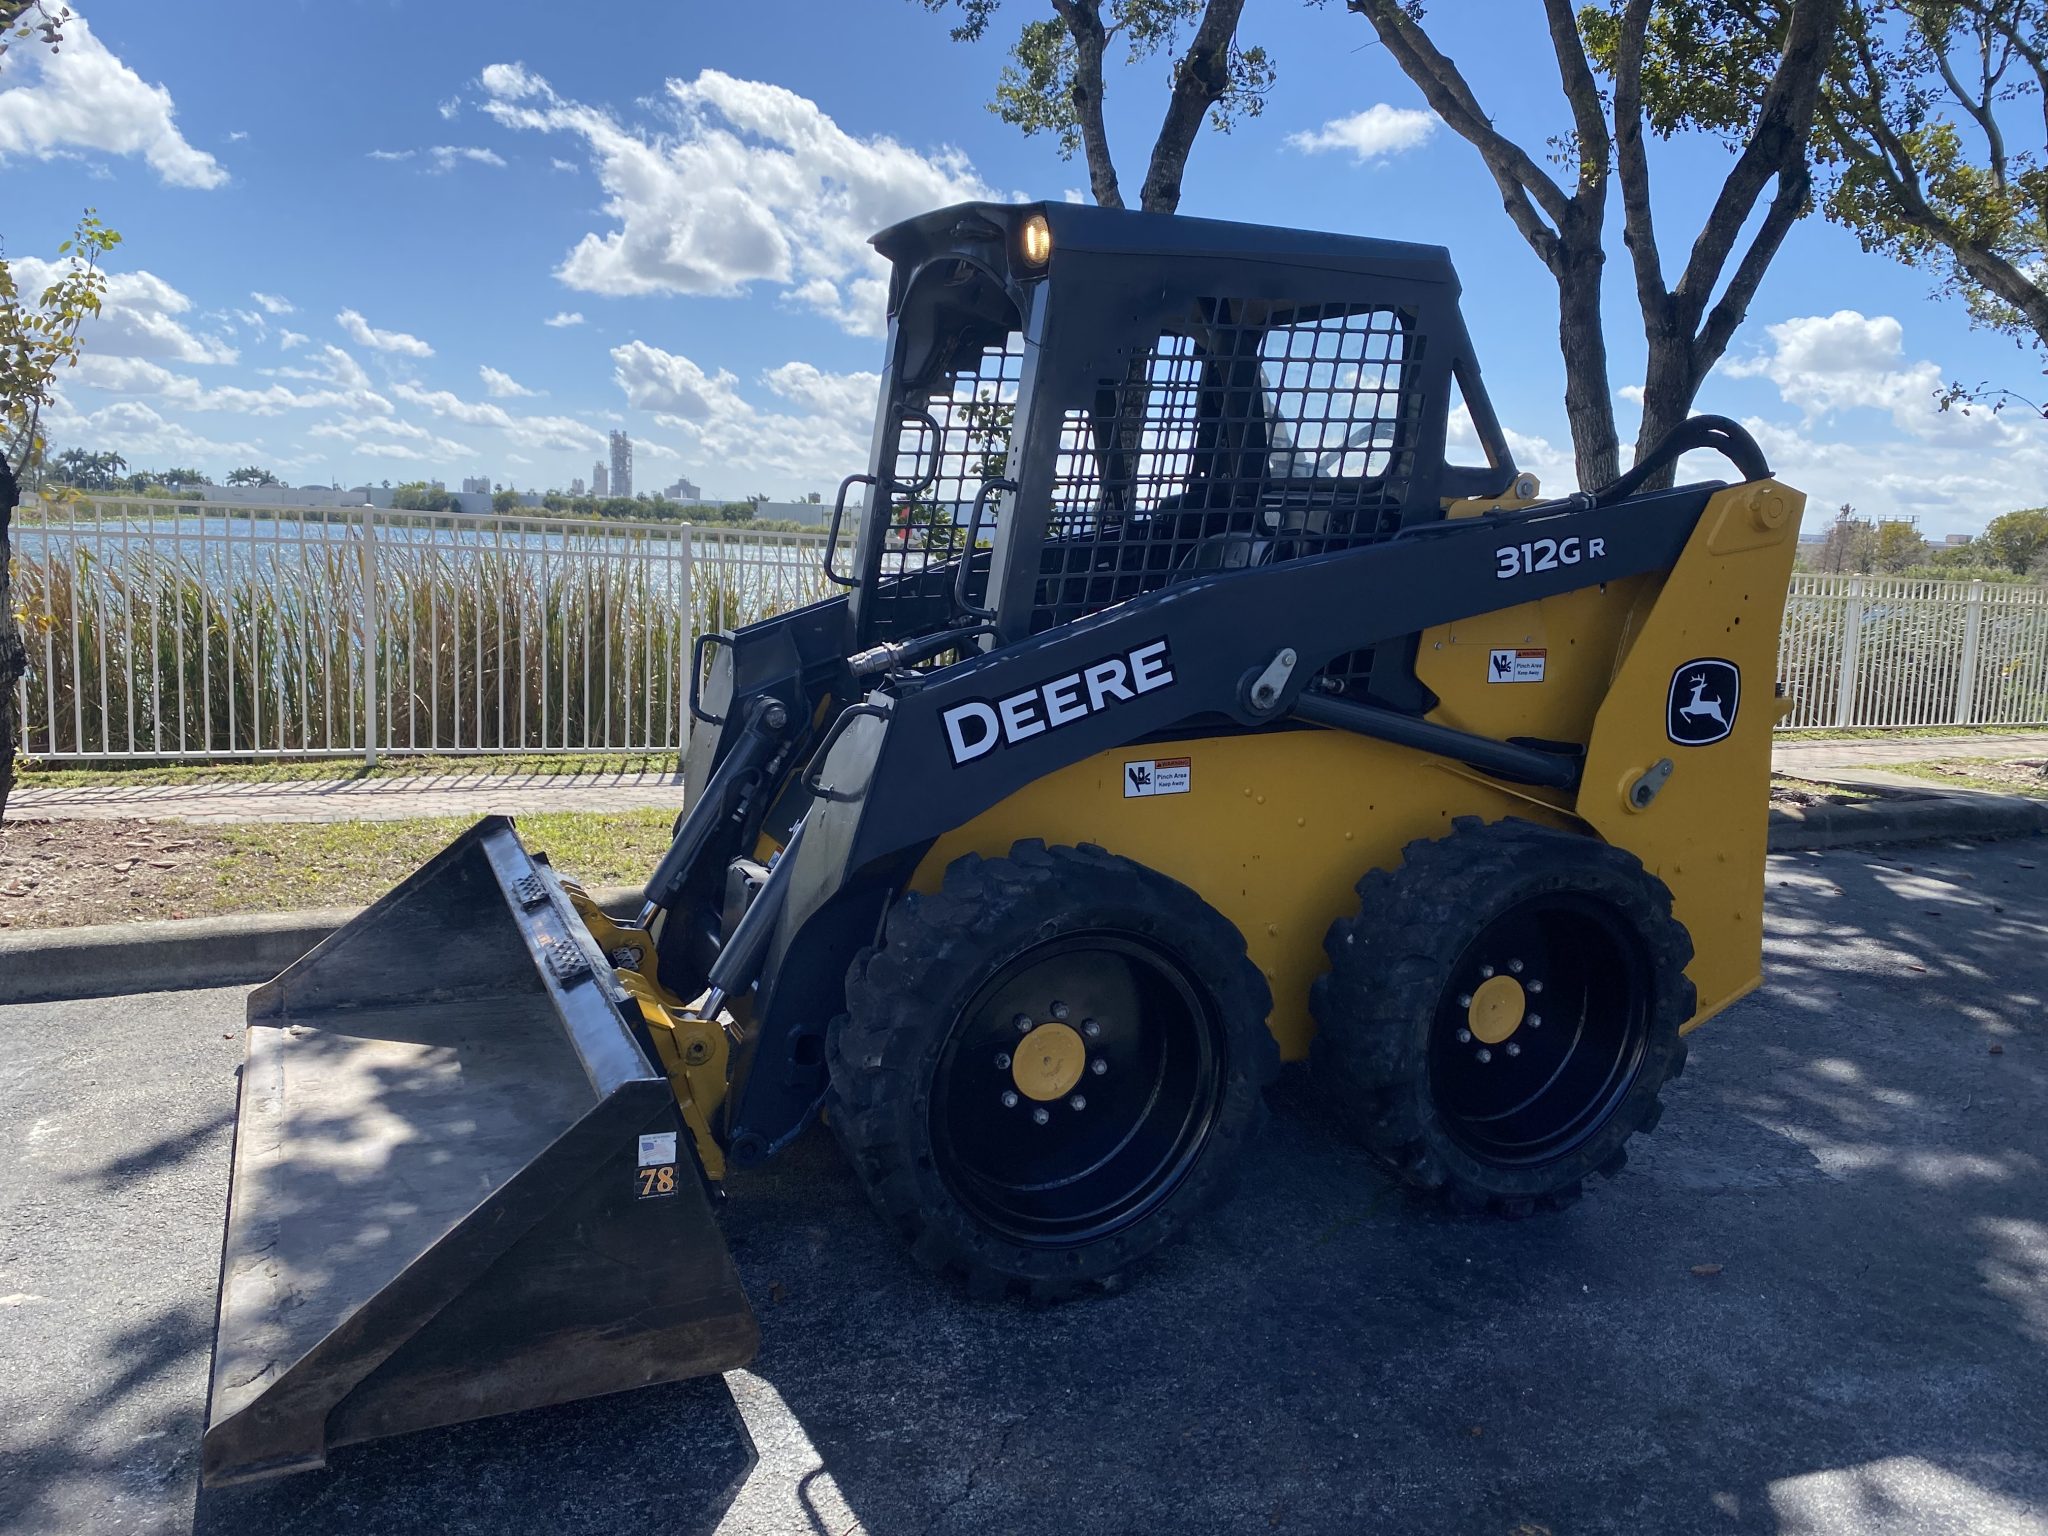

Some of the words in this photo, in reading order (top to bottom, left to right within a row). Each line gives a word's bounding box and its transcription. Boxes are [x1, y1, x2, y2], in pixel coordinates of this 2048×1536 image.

[1496, 537, 1581, 579] 312G
[1588, 538, 1606, 559] R
[943, 640, 1174, 764] DEERE
[640, 1166, 674, 1196] 78
